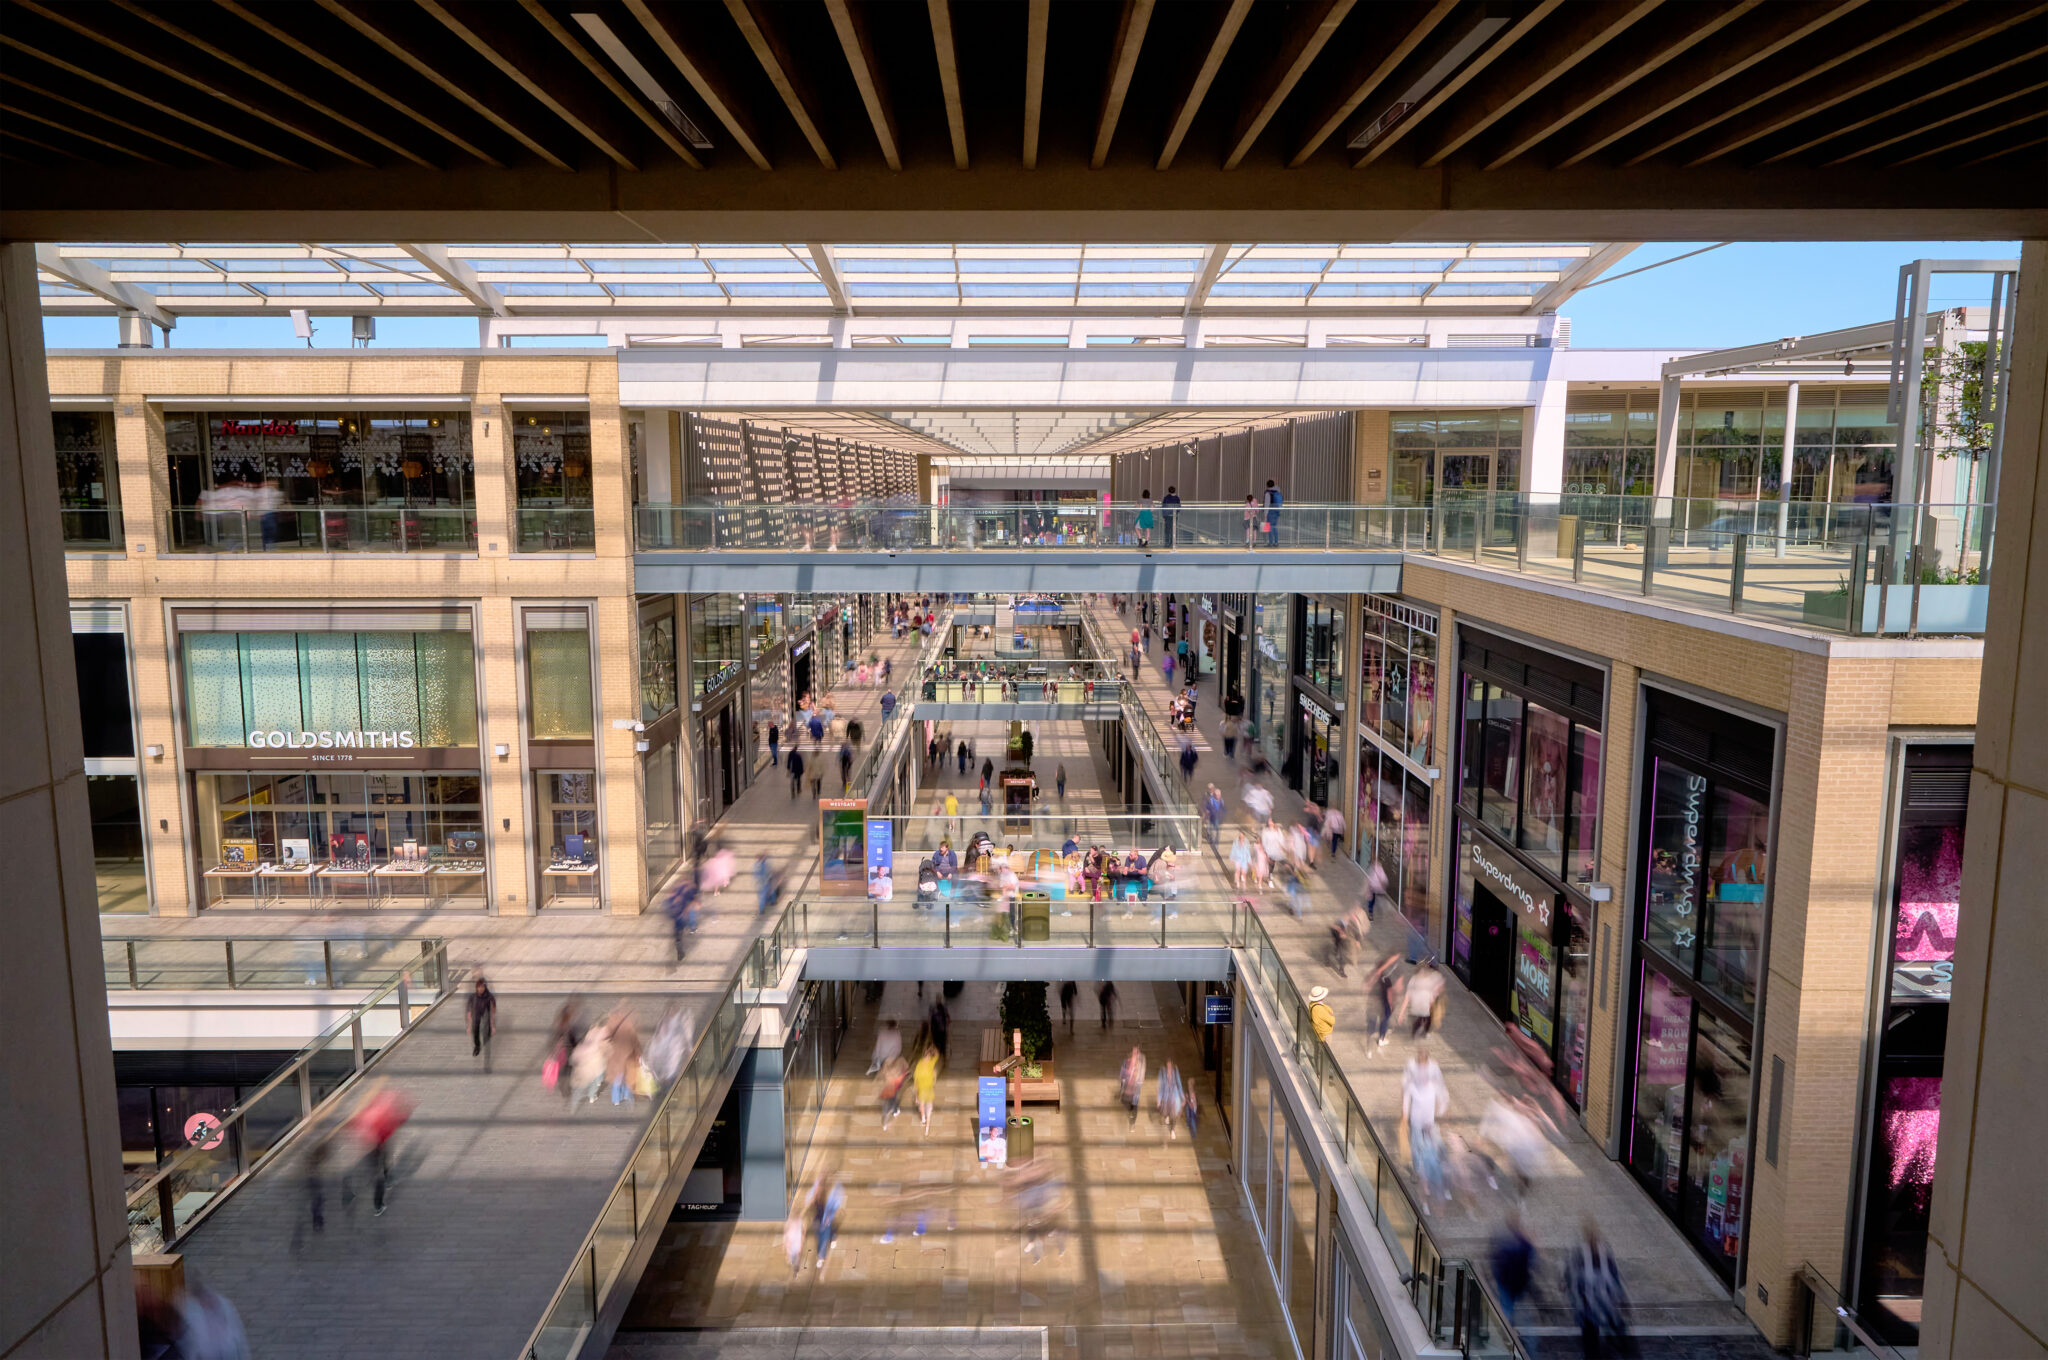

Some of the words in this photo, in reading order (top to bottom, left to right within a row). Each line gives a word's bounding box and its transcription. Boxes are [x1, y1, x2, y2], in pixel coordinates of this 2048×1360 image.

[221, 419, 297, 435] Nando's
[1299, 692, 1330, 726] SKECHERS
[249, 730, 415, 749] GOLDSMITHS
[312, 754, 335, 762] SINCE
[1676, 775, 1707, 919] Superdrug
[1472, 844, 1535, 914] Superdrug
[1520, 954, 1550, 999] MORE
